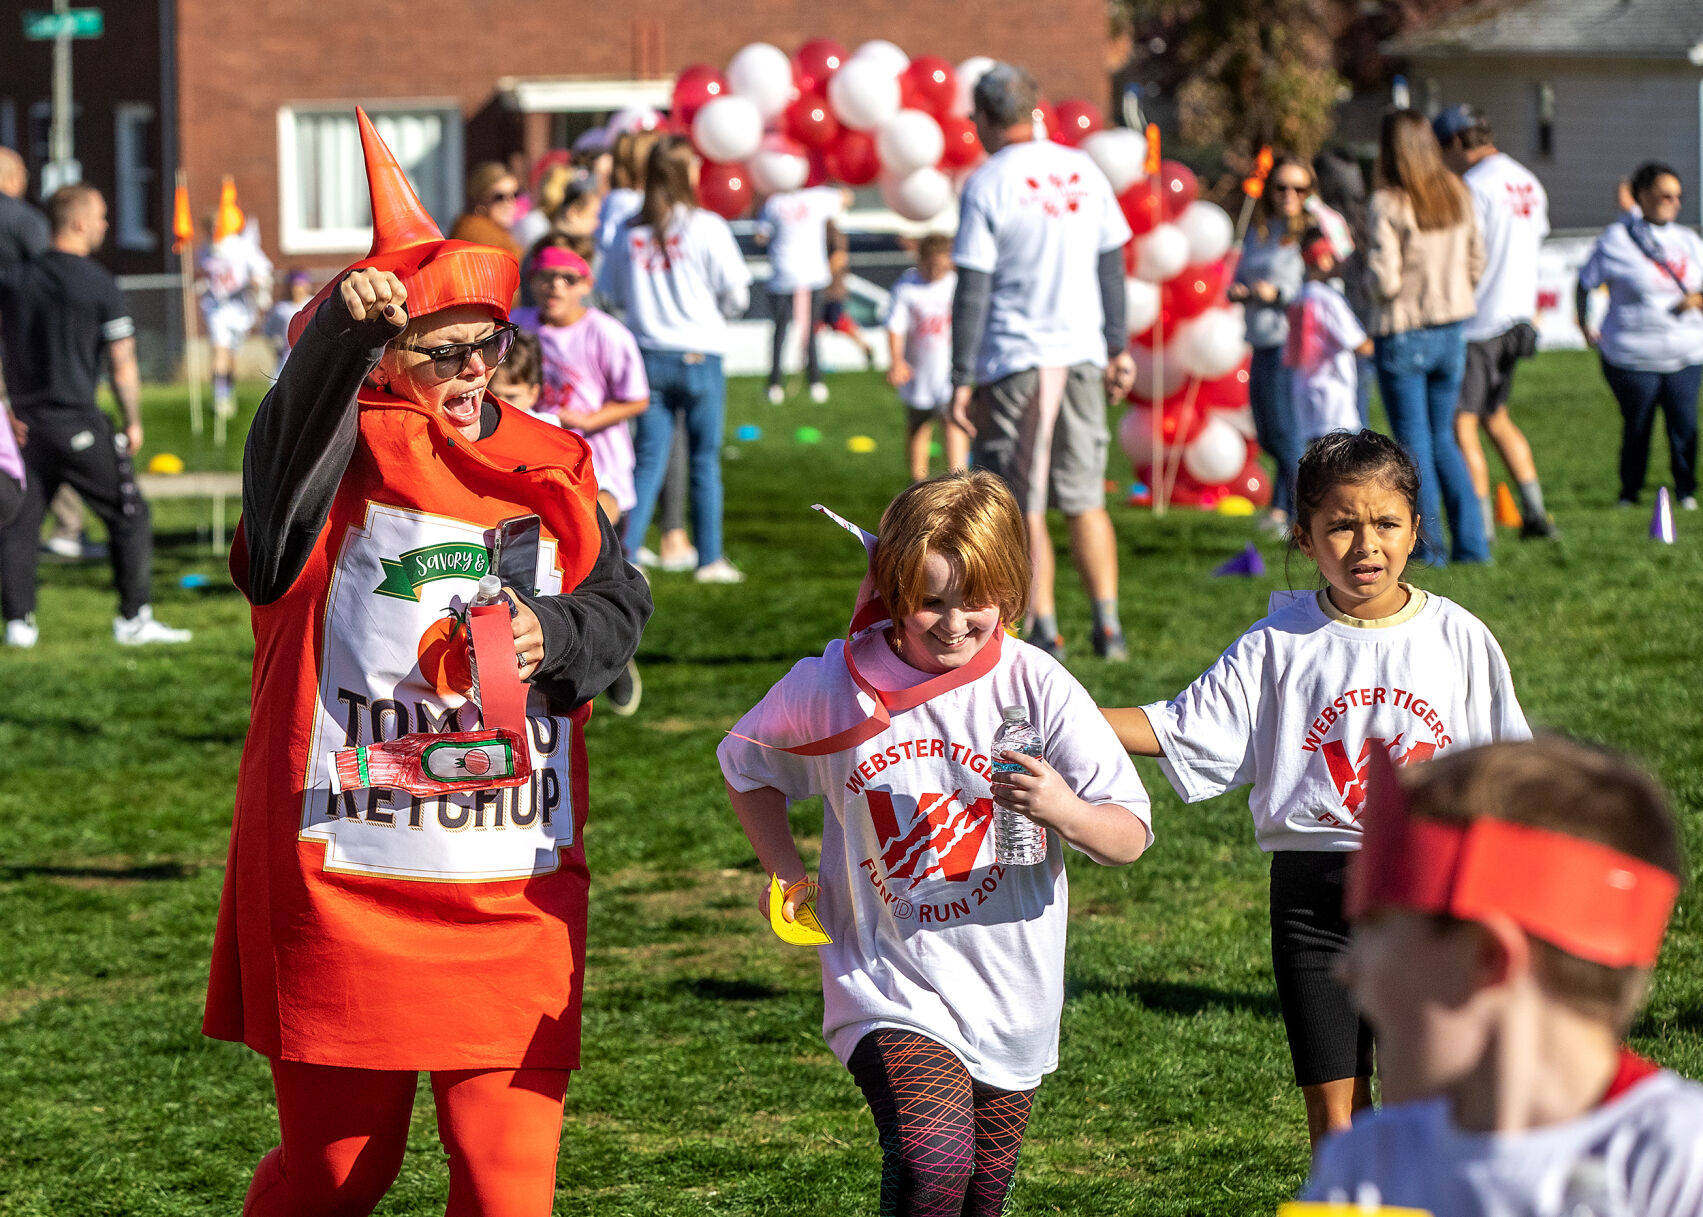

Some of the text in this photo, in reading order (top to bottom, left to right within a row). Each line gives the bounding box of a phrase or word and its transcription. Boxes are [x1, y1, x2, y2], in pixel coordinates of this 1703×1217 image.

[1301, 687, 1453, 753] WEBSTER TIGERS
[845, 738, 993, 796] WEBSTER TIGE
[919, 898, 971, 923] RUN
[971, 863, 1007, 906] 202
